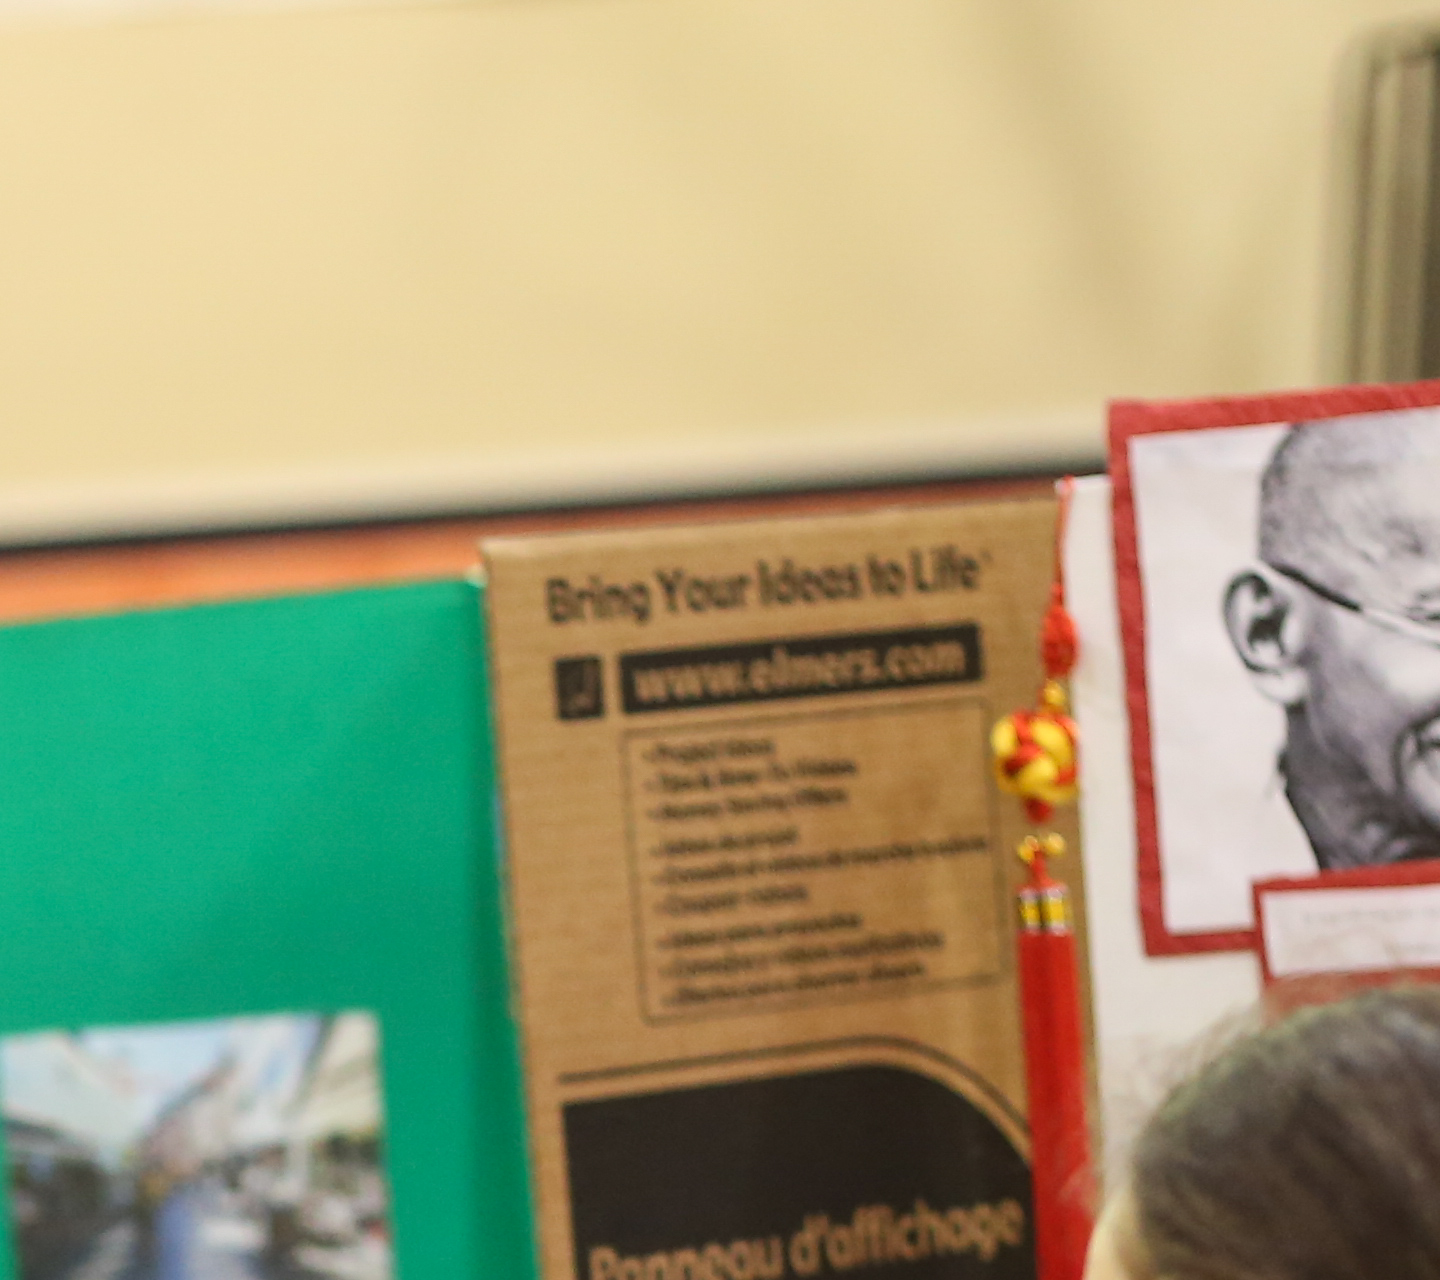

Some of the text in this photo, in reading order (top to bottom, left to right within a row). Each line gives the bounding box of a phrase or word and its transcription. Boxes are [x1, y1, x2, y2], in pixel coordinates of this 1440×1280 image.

[545, 577, 652, 625] Bring
[655, 567, 748, 614] Your
[757, 556, 861, 606] Ideas
[867, 550, 906, 598] to
[632, 637, 968, 703] www.elmers.com
